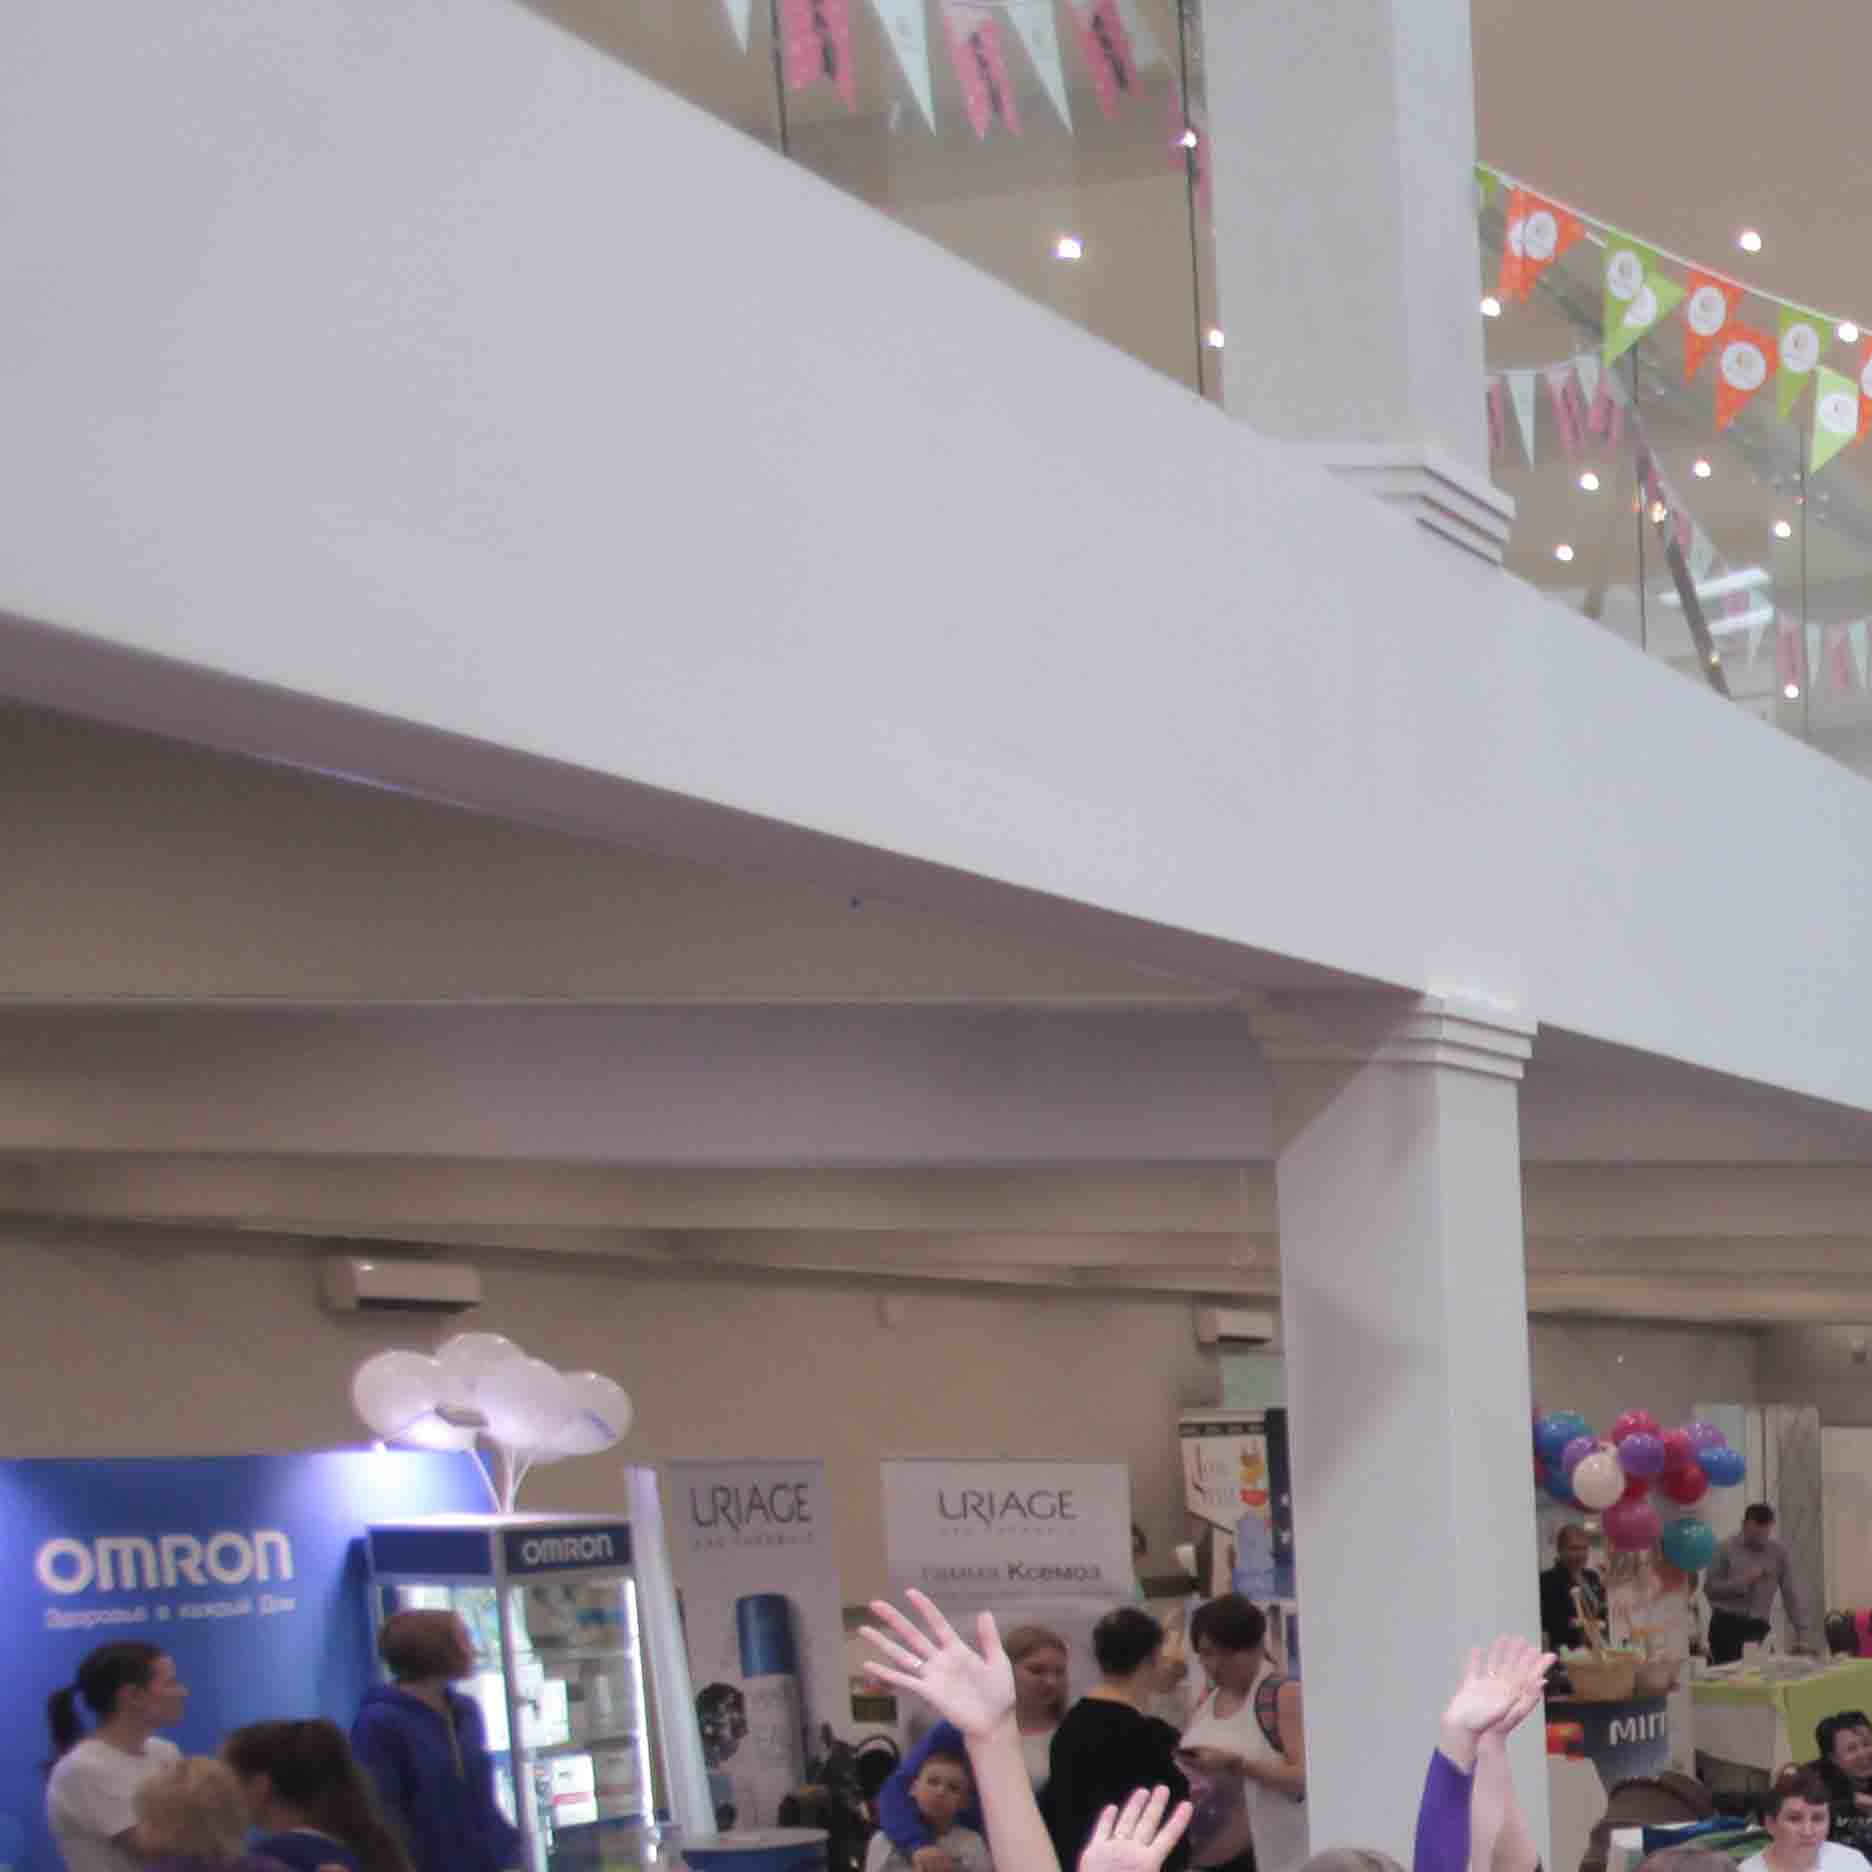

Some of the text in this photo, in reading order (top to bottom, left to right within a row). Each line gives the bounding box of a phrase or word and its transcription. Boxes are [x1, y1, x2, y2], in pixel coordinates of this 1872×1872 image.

[690, 1482, 813, 1532] URIAGE
[937, 1488, 1079, 1527] URIAGE
[35, 1530, 294, 1595] OMRON
[521, 1532, 614, 1566] OMRON
